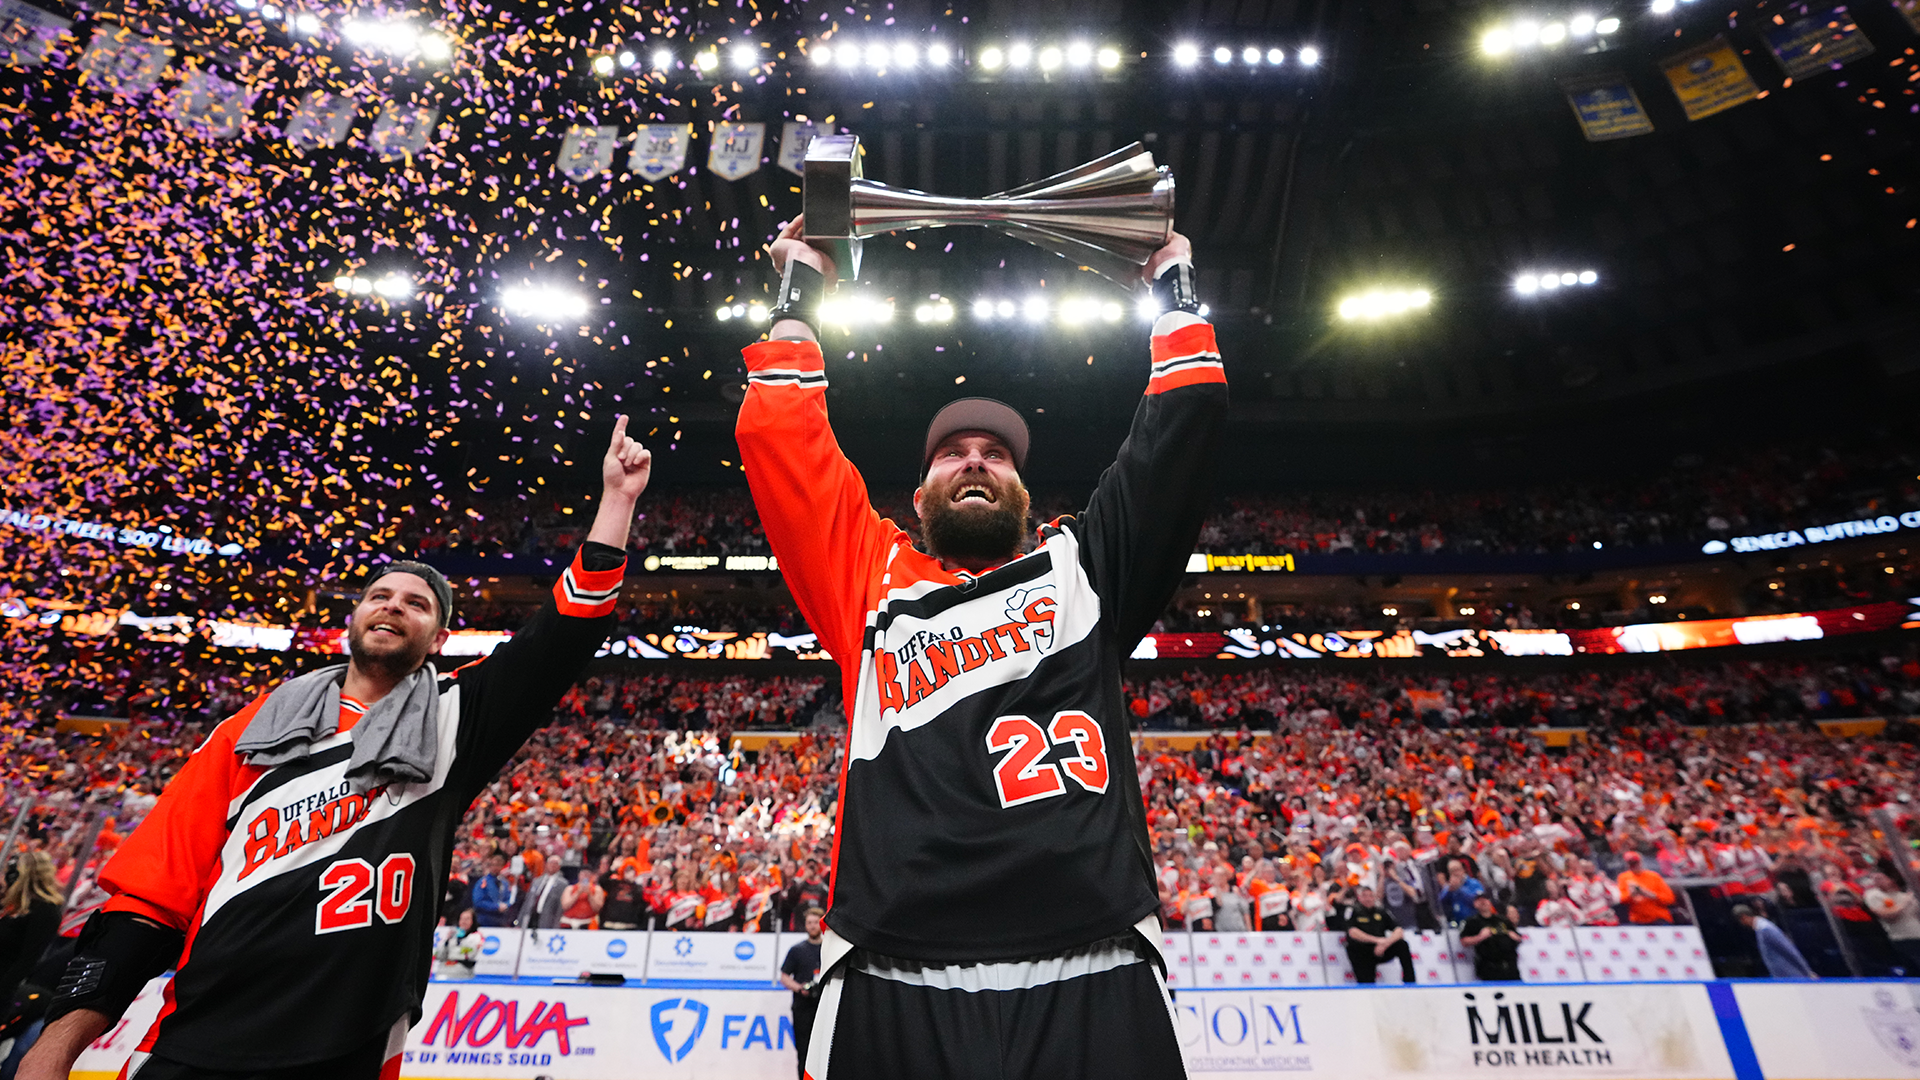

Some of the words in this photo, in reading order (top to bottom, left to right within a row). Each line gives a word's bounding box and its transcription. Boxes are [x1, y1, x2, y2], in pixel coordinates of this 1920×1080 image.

[118, 528, 160, 547] 300
[1730, 530, 1806, 553] SENECA
[1804, 515, 1900, 544] BUFFALO
[985, 710, 1110, 810] 23
[314, 853, 416, 936] 20
[422, 989, 590, 1056] NOVA
[1465, 1000, 1603, 1044] MILK
[446, 1051, 503, 1066] WINGS
[507, 1052, 552, 1067] SOLD
[1473, 1050, 1517, 1067] FOR
[1525, 1049, 1613, 1066] HEALTH
